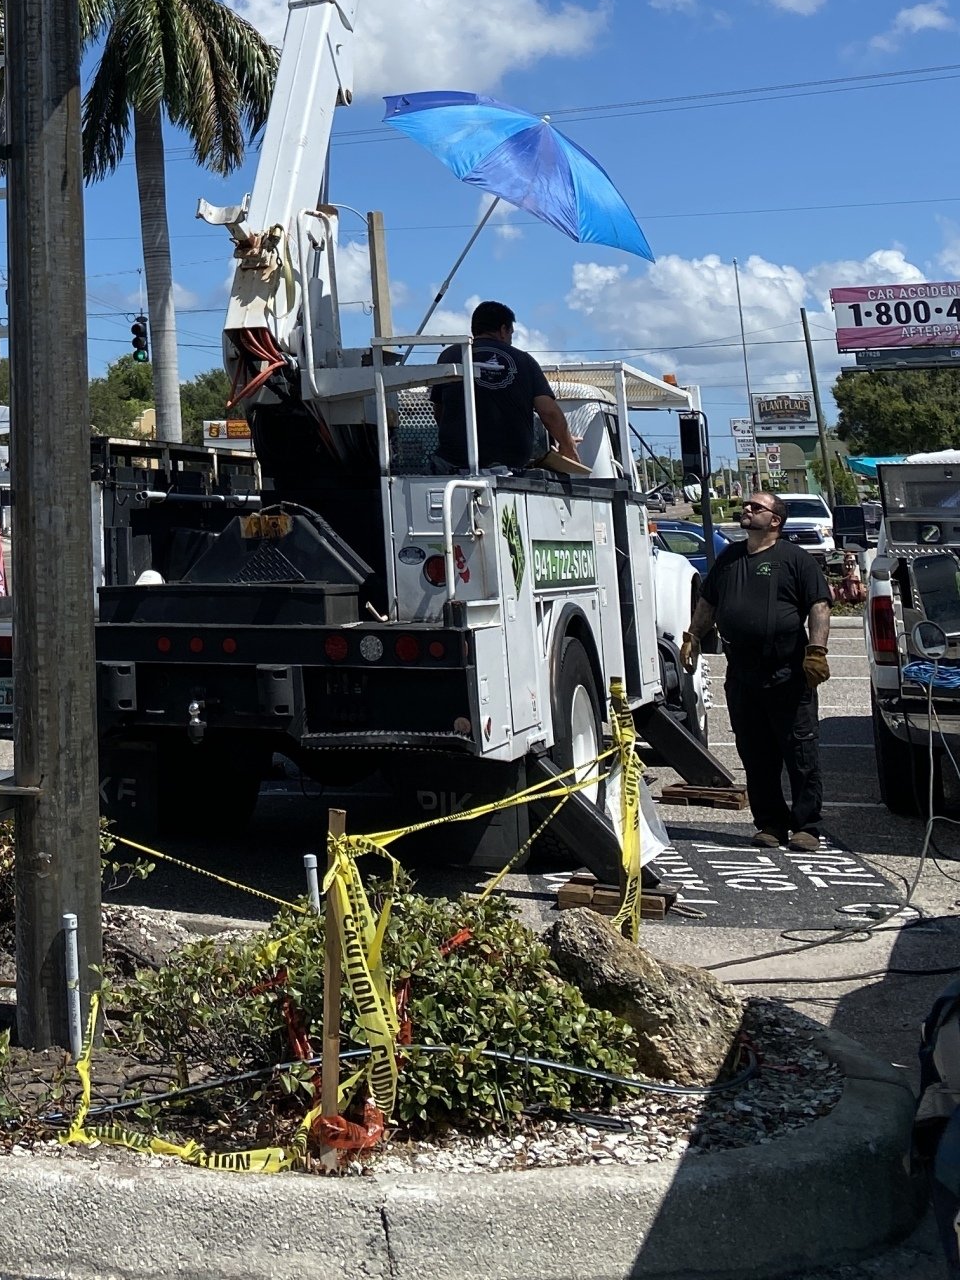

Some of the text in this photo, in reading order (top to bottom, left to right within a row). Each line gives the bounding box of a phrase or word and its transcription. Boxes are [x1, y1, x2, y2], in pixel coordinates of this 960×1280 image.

[867, 288, 895, 300] CAR
[901, 325, 942, 338] AFTER
[760, 399, 808, 412] PLANT PLACE
[534, 548, 595, 581] 941-722-SIGN
[691, 843, 799, 891] ONLY
[343, 914, 378, 1016] CAUTION
